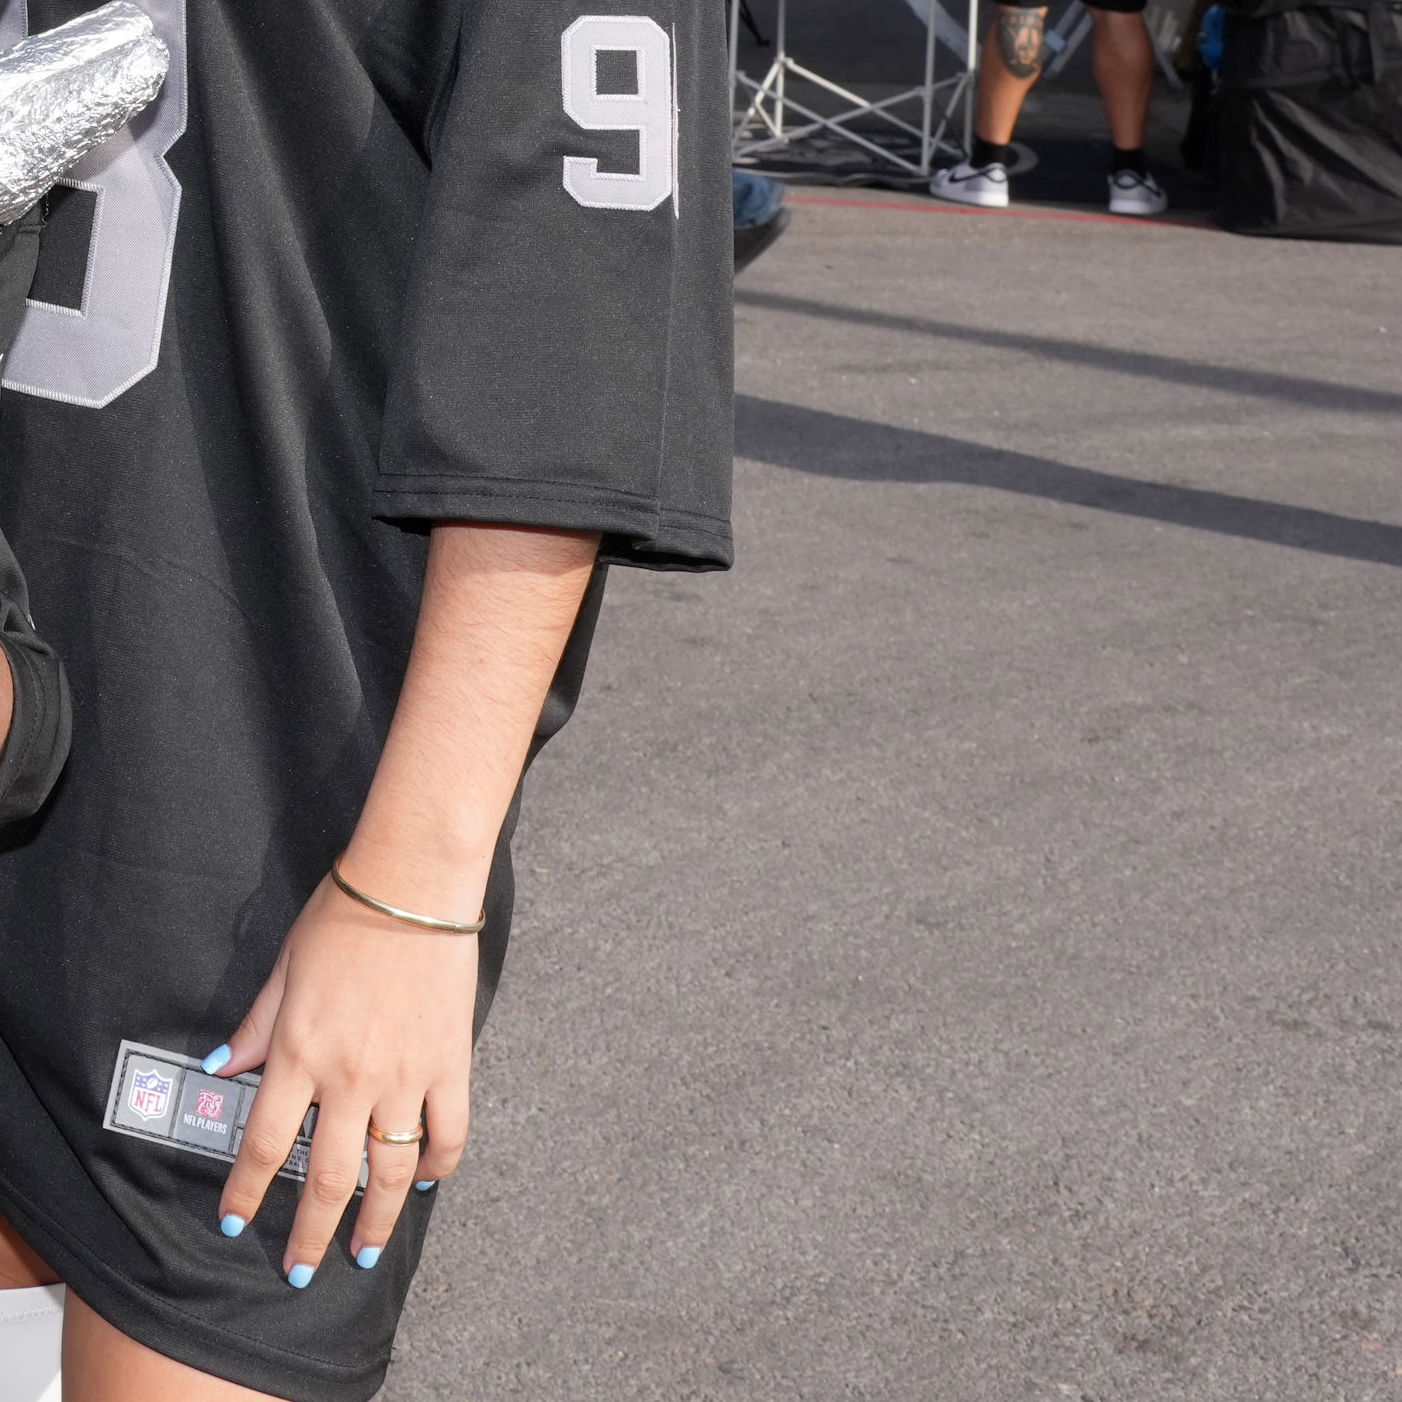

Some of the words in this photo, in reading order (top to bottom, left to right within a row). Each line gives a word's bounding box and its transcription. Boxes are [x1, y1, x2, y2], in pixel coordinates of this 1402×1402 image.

[560, 14, 673, 212] 9
[134, 1088, 164, 1113] NFL
[182, 1112, 198, 1127] NFL
[197, 1114, 228, 1135] PLAYERS
